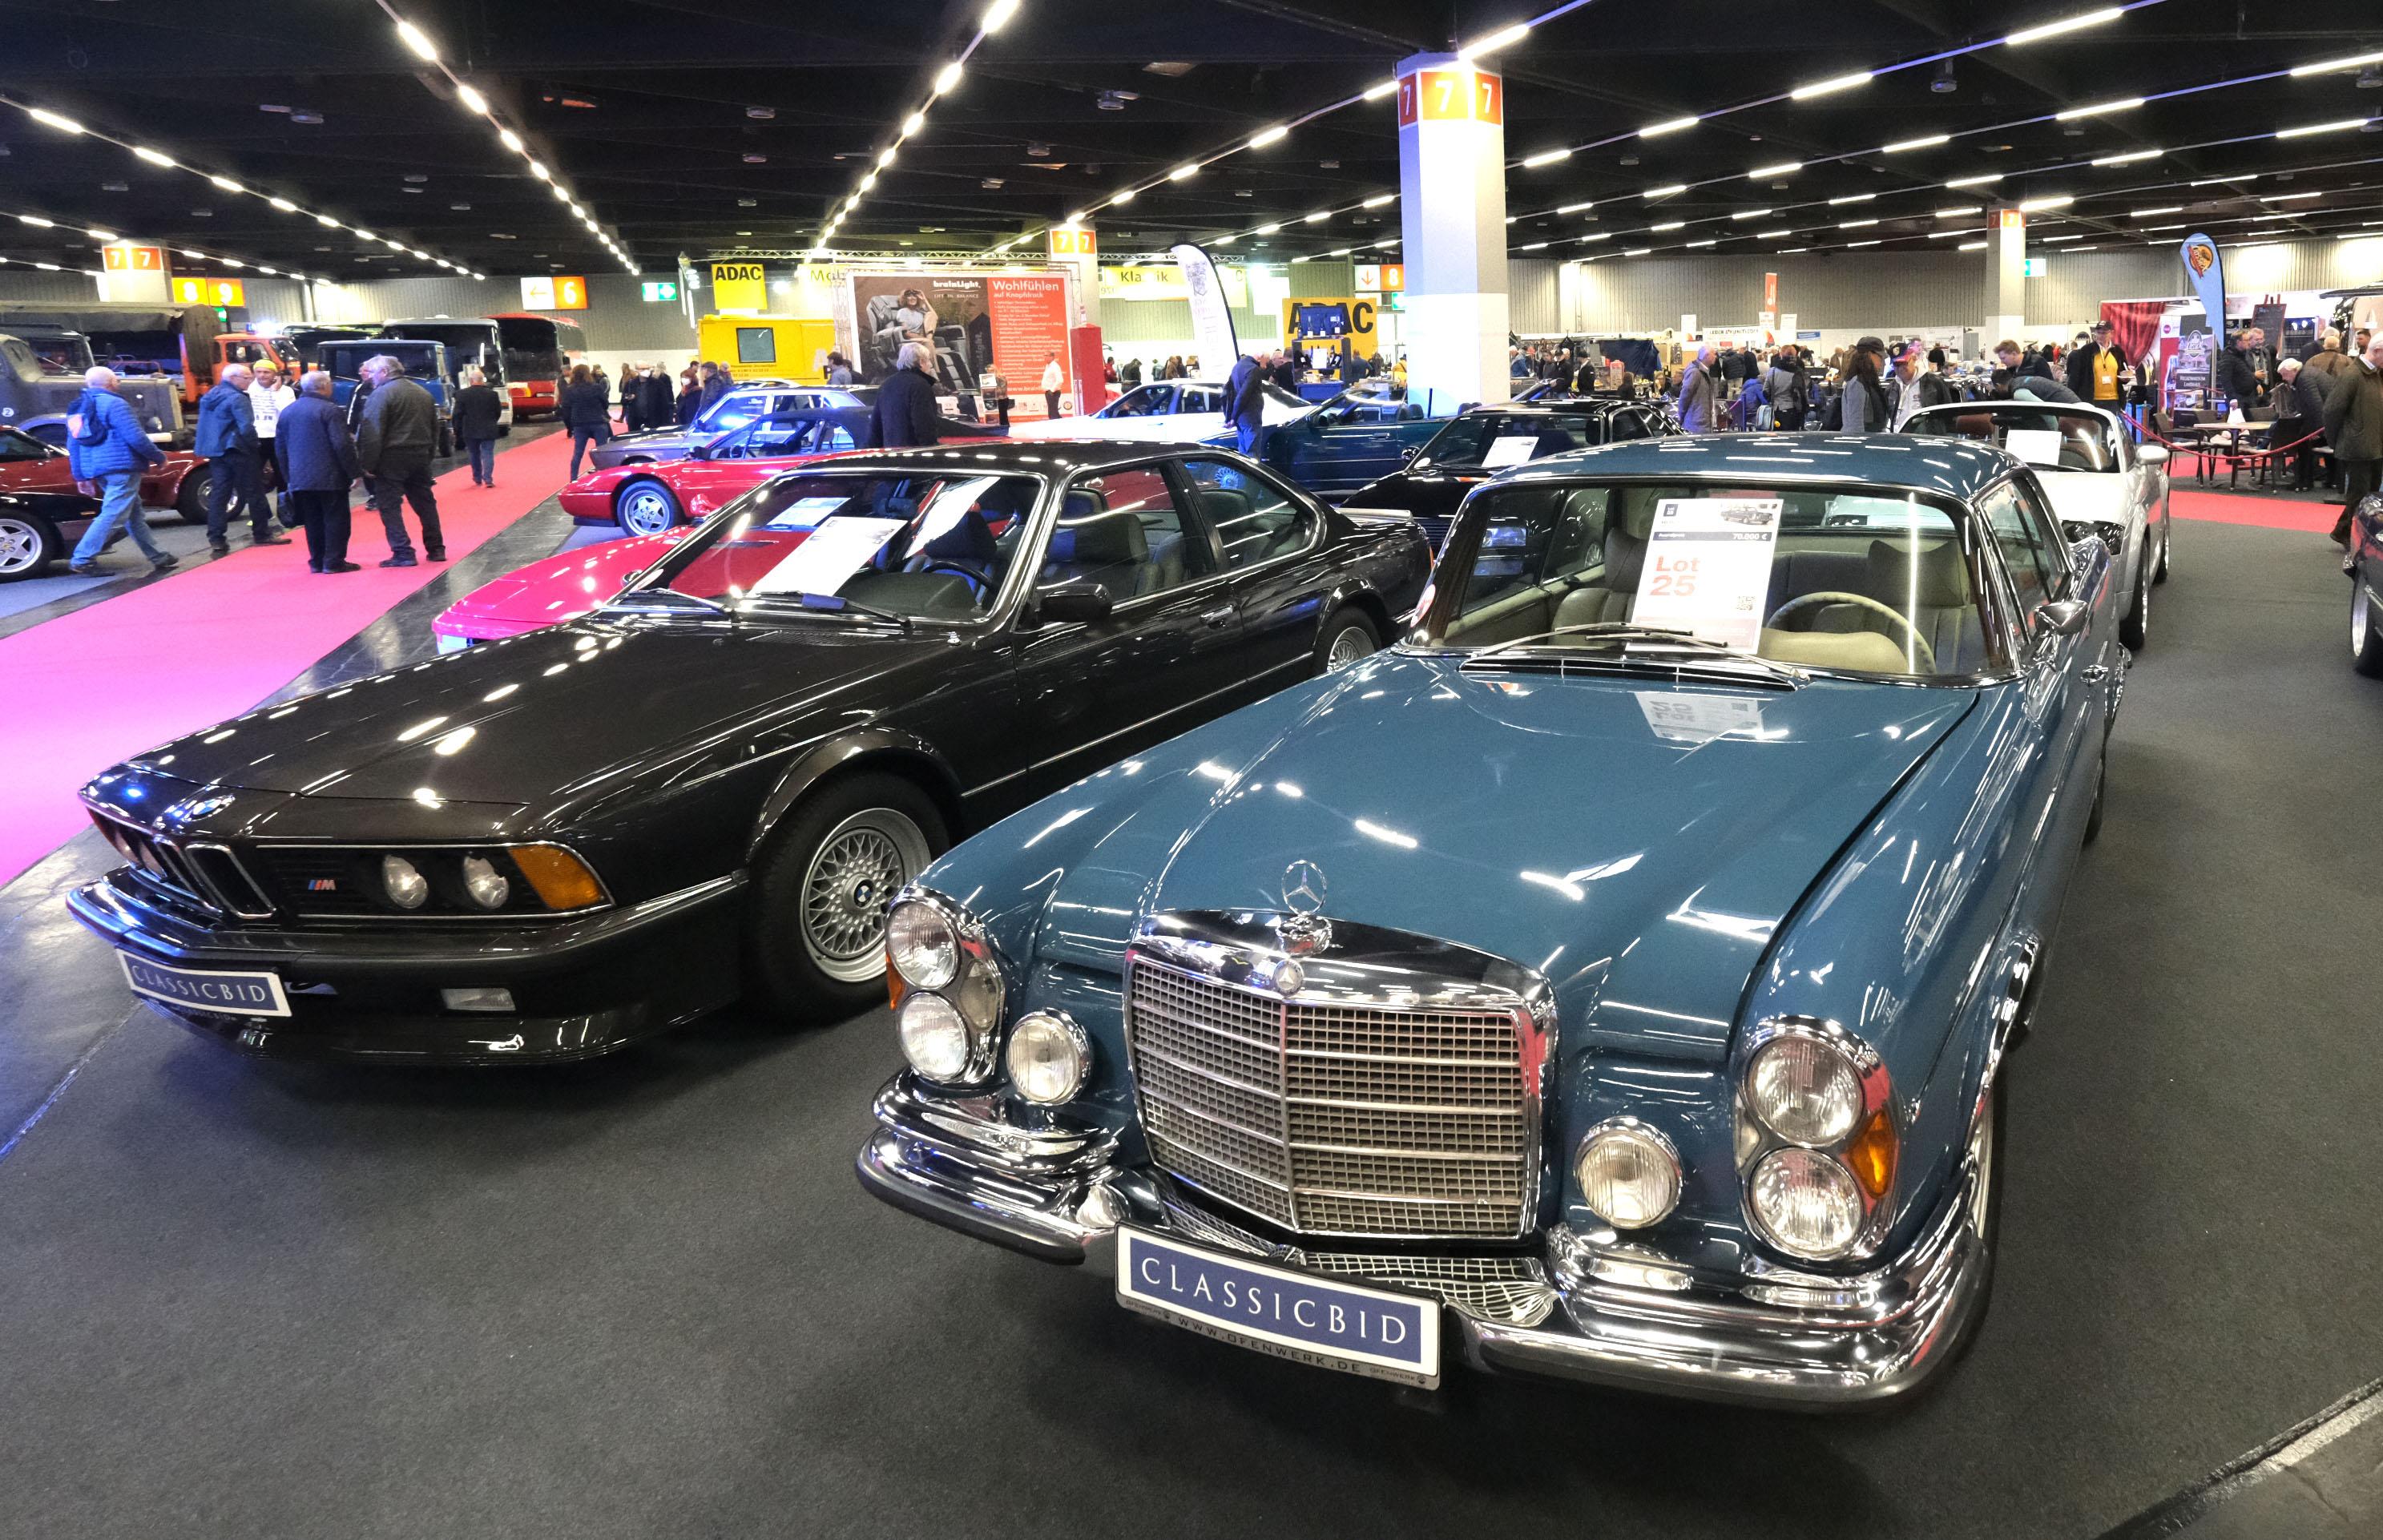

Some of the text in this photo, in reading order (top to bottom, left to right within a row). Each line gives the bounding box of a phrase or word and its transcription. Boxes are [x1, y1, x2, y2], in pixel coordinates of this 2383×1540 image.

[1404, 84, 1411, 115] 7
[1435, 80, 1454, 112] 7
[1482, 83, 1493, 114] 7
[1058, 235, 1067, 250] 7
[1082, 235, 1090, 250] 7
[111, 252, 120, 267] 7
[139, 252, 151, 267] 7
[716, 266, 762, 281] ADAC
[1120, 270, 1169, 282] Klaik
[1389, 268, 1399, 286] 8
[183, 281, 232, 304] 8 9
[563, 281, 576, 304] 6
[993, 280, 1059, 292] Wohlfühlen
[1288, 302, 1374, 334] AAC
[1655, 555, 1701, 572] Lot
[1649, 574, 1697, 596] 25
[131, 966, 266, 1002] CLASSICBID
[1141, 1256, 1407, 1344] CLASSICBID
